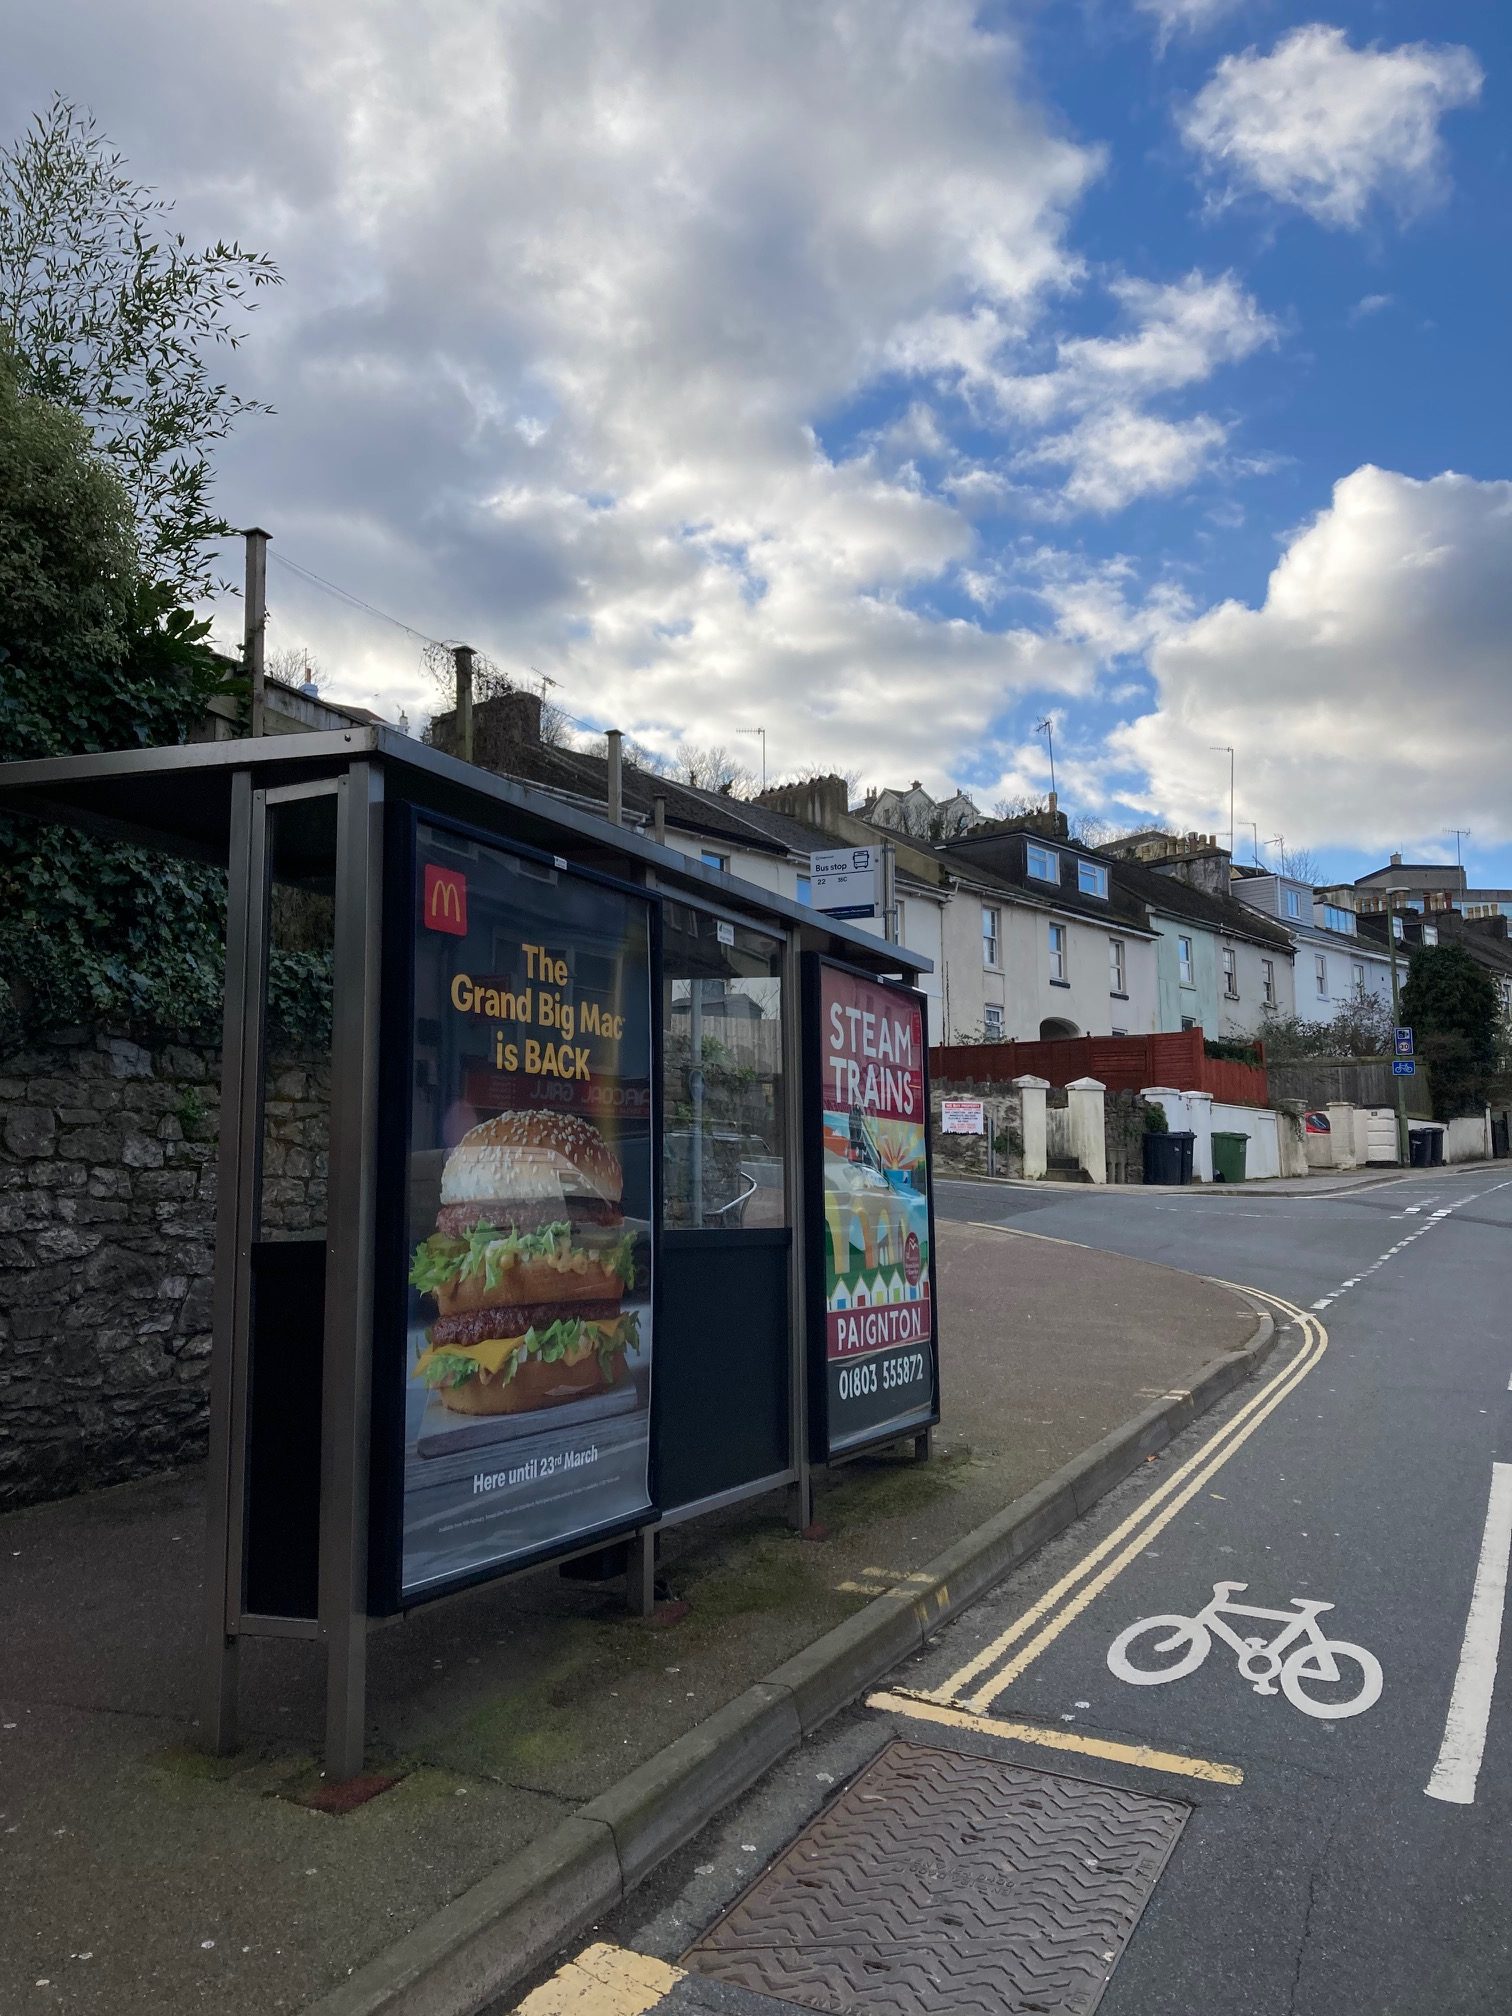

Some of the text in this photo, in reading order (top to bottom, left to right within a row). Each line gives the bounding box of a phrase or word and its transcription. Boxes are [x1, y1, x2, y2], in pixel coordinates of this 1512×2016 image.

[816, 863, 847, 872] Bus stop
[522, 943, 568, 986] The
[451, 973, 624, 1041] Grand Big Mac
[496, 1031, 591, 1081] is BACK
[829, 1002, 912, 1066] STEAM
[829, 1056, 914, 1115] TRAINS
[837, 1307, 921, 1351] PAIGNTON
[838, 1353, 923, 1400] 01803 555872
[473, 1445, 598, 1494] Here until 23rd March
